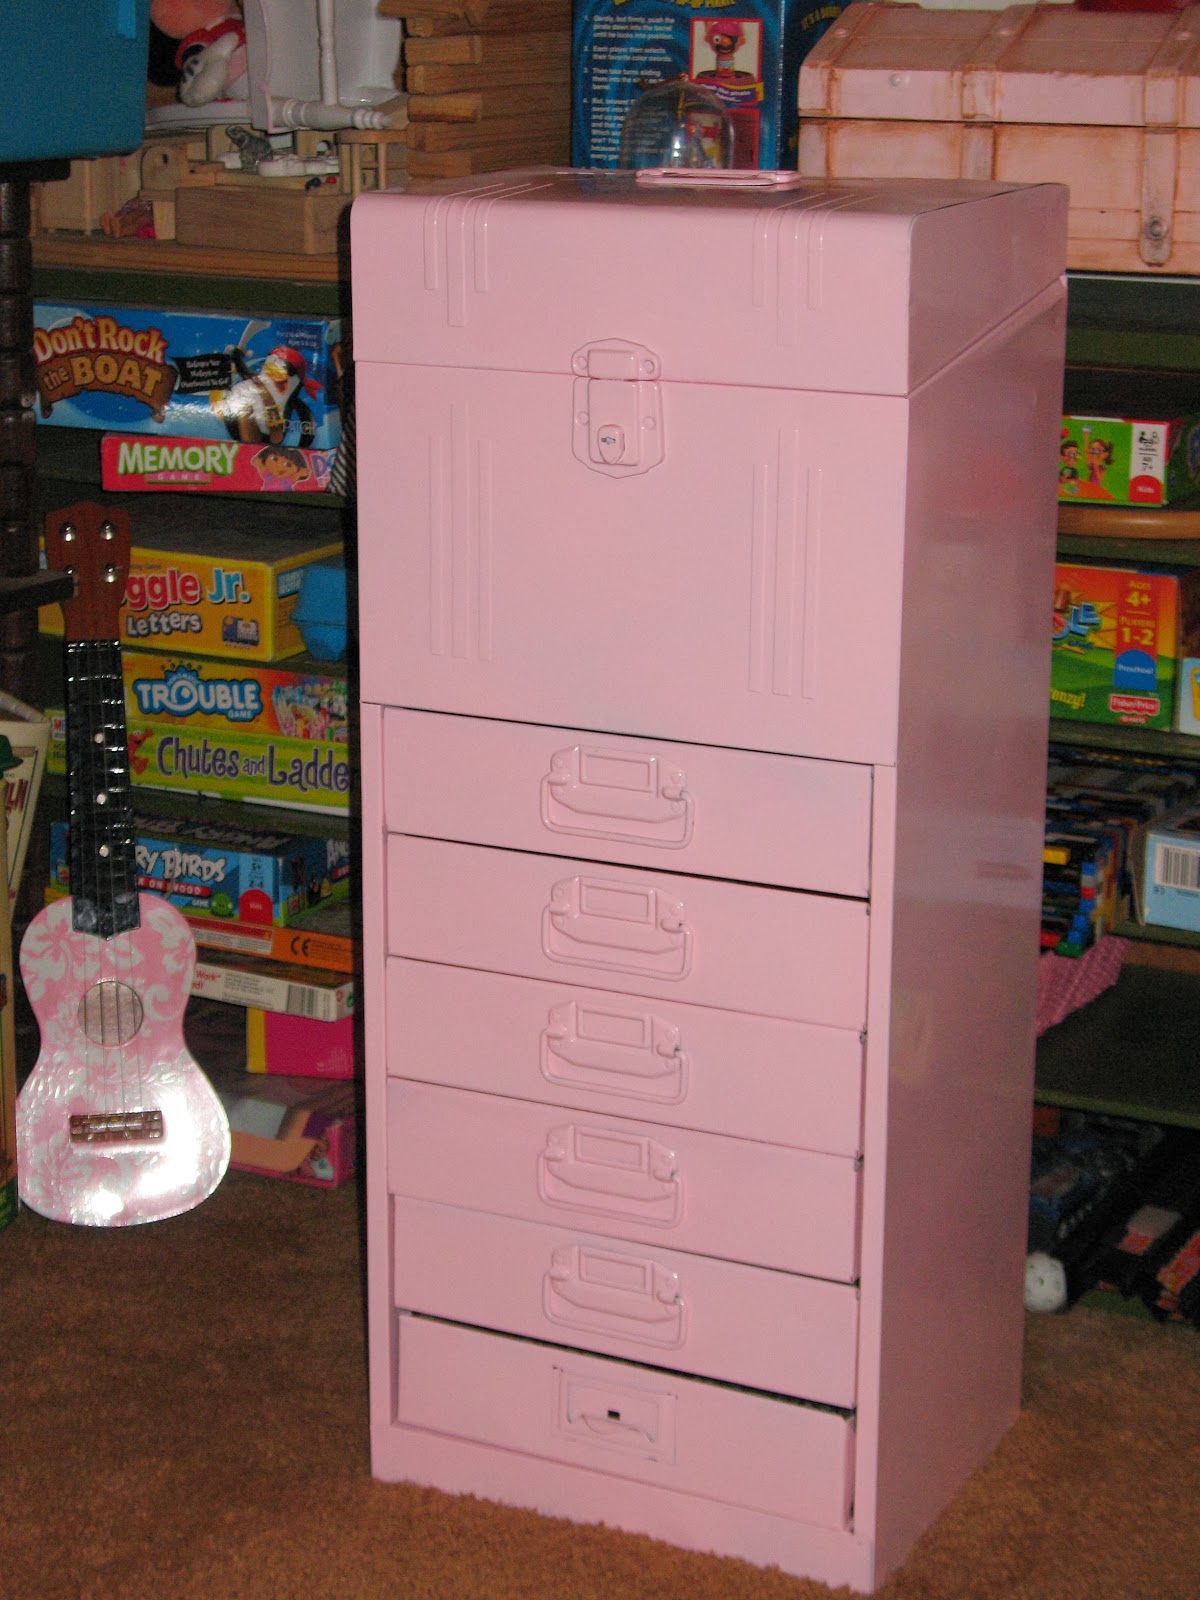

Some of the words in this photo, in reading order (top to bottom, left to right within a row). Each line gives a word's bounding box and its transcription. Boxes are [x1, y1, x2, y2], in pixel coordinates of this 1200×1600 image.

[34, 317, 98, 365] Don't
[97, 316, 167, 365] Rock
[43, 366, 70, 391] the
[70, 354, 162, 397] BOAT
[117, 441, 239, 476] MEMORY
[157, 473, 200, 481] GAME
[122, 569, 200, 611] ggle
[207, 568, 250, 604] Jr.
[1125, 591, 1151, 607] 4+
[126, 612, 202, 638] Letters
[1122, 627, 1154, 646] 1-2
[137, 680, 260, 713] TROUBLE
[228, 710, 252, 720] GAME
[156, 736, 239, 780] Chutes
[242, 754, 265, 775] and
[160, 849, 226, 883] BIRDS
[148, 878, 164, 889] ON
[191, 899, 209, 907] GAME
